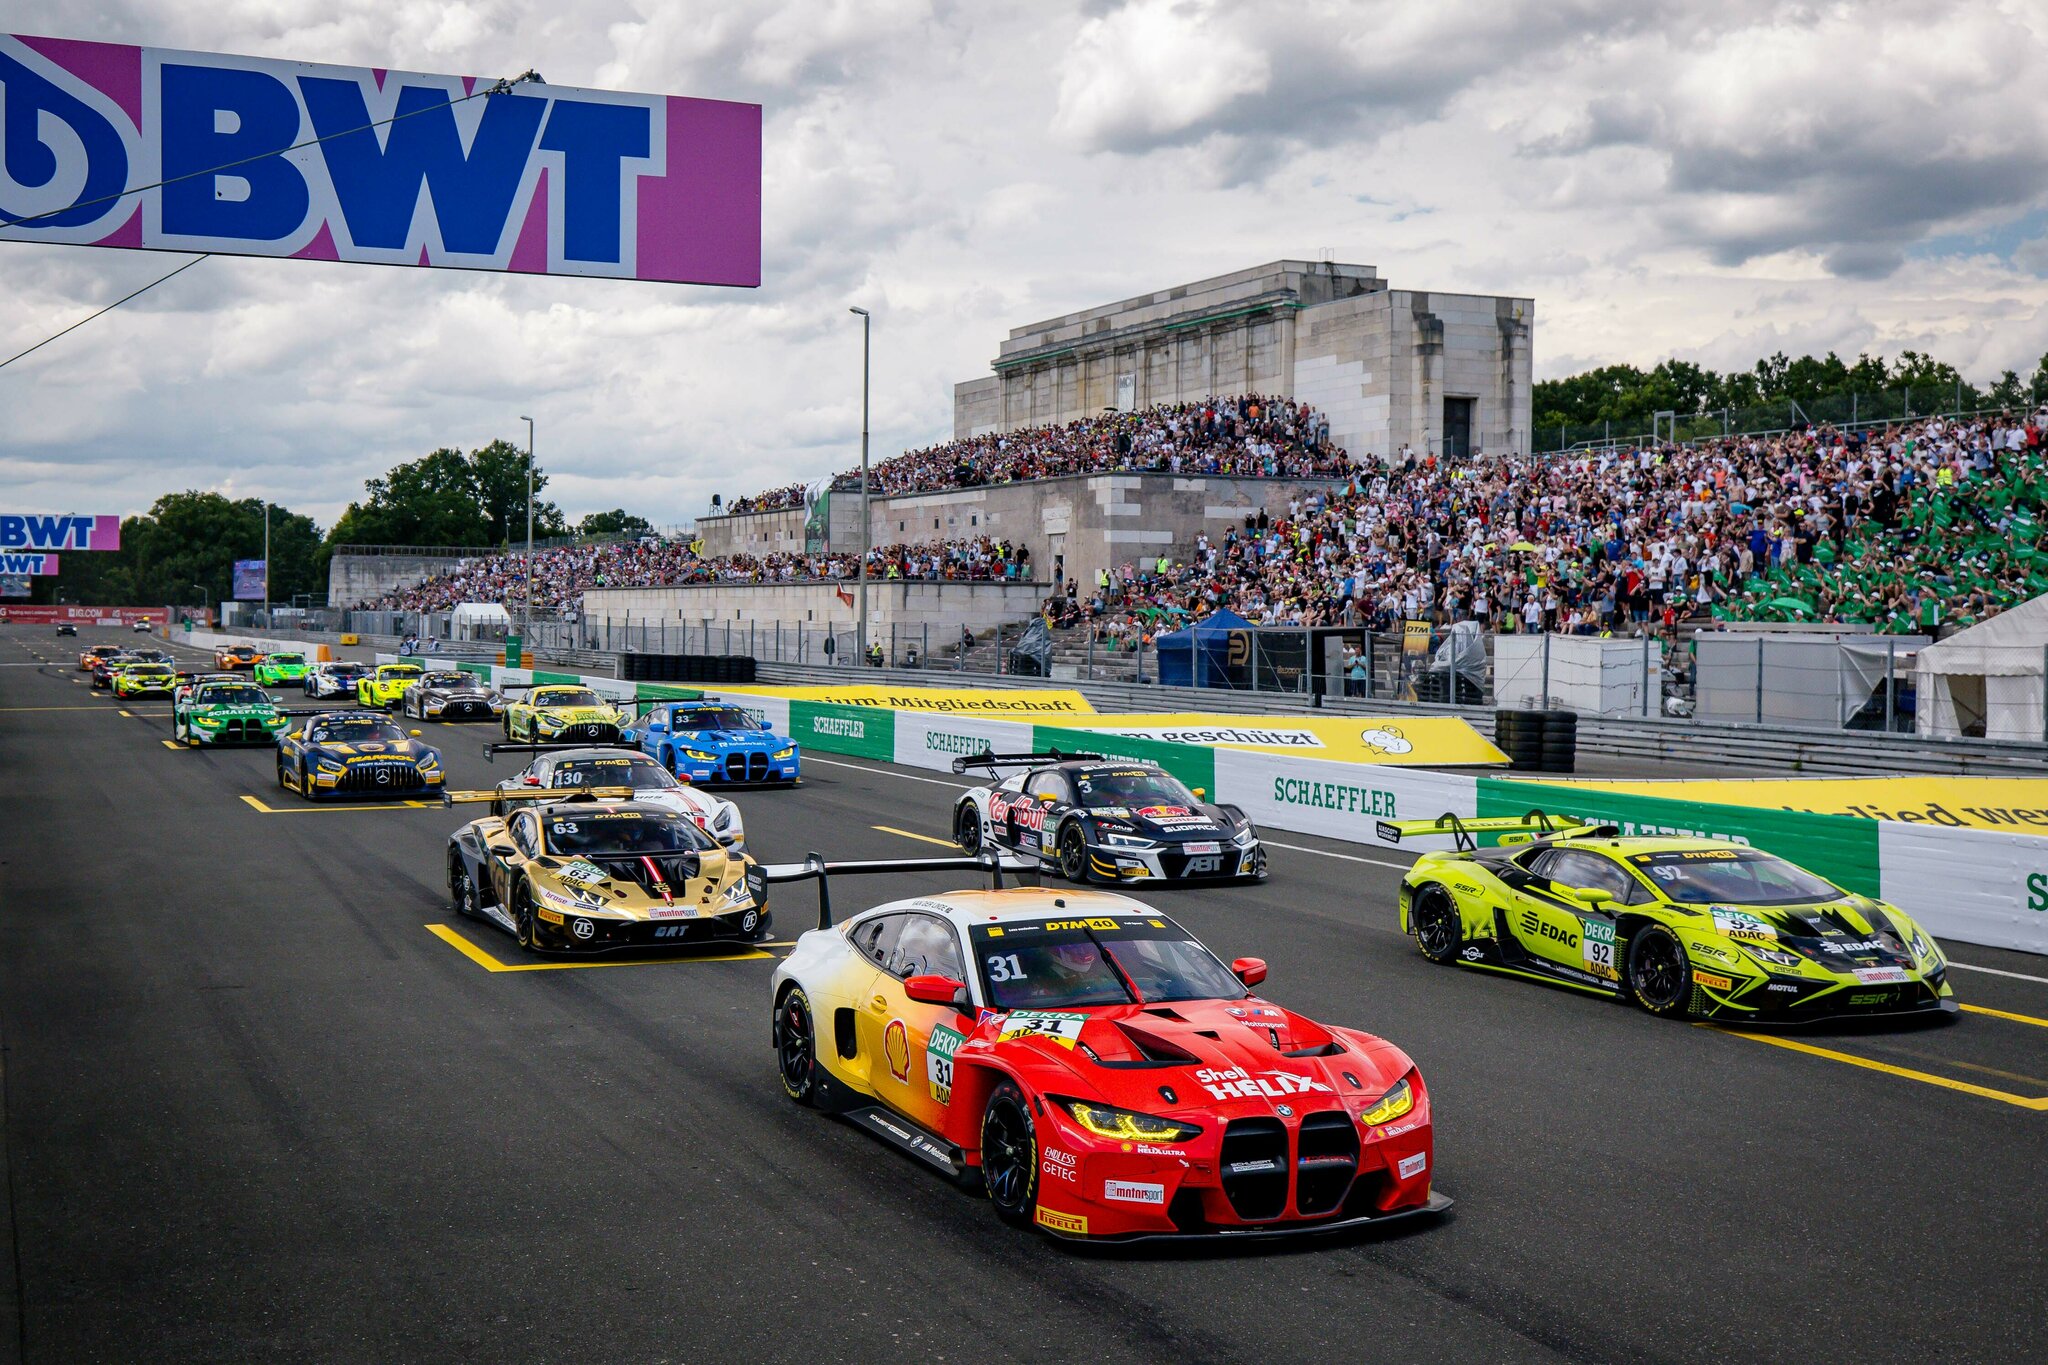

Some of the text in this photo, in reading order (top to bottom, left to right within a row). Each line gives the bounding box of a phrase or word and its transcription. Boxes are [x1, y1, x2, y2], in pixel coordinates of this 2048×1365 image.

[161, 63, 651, 263] BWT
[0, 516, 93, 548] BWT
[0, 555, 44, 574] WT
[76, 609, 102, 617] IG.COM
[1406, 626, 1428, 634] DTM
[208, 709, 276, 717] SCHAEFFLER
[675, 715, 689, 723] 33
[813, 716, 864, 738] SCHAEFFLER
[313, 731, 329, 741] 36
[926, 731, 991, 754] SCHAEFFLER
[346, 755, 416, 764] MANNOL
[555, 771, 583, 786] 130
[1078, 780, 1092, 794] 3
[1274, 777, 1397, 818] SCHAEFFLER
[989, 792, 1048, 830] Red Bull
[553, 822, 579, 835] 63
[1043, 820, 1056, 831] DEKR
[1048, 834, 1053, 846] 3
[1682, 851, 1714, 859] DTM
[569, 869, 591, 880] 63
[1180, 856, 1224, 878] ABT
[1652, 865, 1690, 881] 92
[557, 875, 586, 887] ADAC
[1454, 883, 1477, 893] SSR
[545, 892, 568, 904] brose
[540, 910, 561, 922] PIRELLI
[658, 909, 698, 918] motorsport
[575, 921, 593, 936] ZF
[1046, 919, 1114, 931] DTM 40
[1731, 919, 1760, 931] 92
[1540, 921, 1578, 949] EDAG
[1728, 930, 1766, 940] ADAC
[1690, 942, 1727, 957] SSR
[1842, 940, 1886, 951] EDAG
[1592, 943, 1609, 964] 92
[987, 953, 1028, 982] 31
[1590, 963, 1612, 978] ADAC
[1696, 973, 1728, 988] PIRELLI
[1767, 983, 1798, 993] MOTUL
[1012, 1011, 1085, 1020] DEKRA
[1023, 1018, 1063, 1034] 31
[1240, 1020, 1288, 1029] Motorsport
[930, 1029, 962, 1057] DEKR
[935, 1058, 952, 1087] 31
[1195, 1066, 1249, 1083] Shell
[1203, 1073, 1333, 1101] HELIX
[1044, 1146, 1078, 1166] ENDLESS
[1042, 1161, 1077, 1182] GETEC
[1116, 1185, 1163, 1202] motorsport
[1039, 1209, 1083, 1231] PIRELLI
